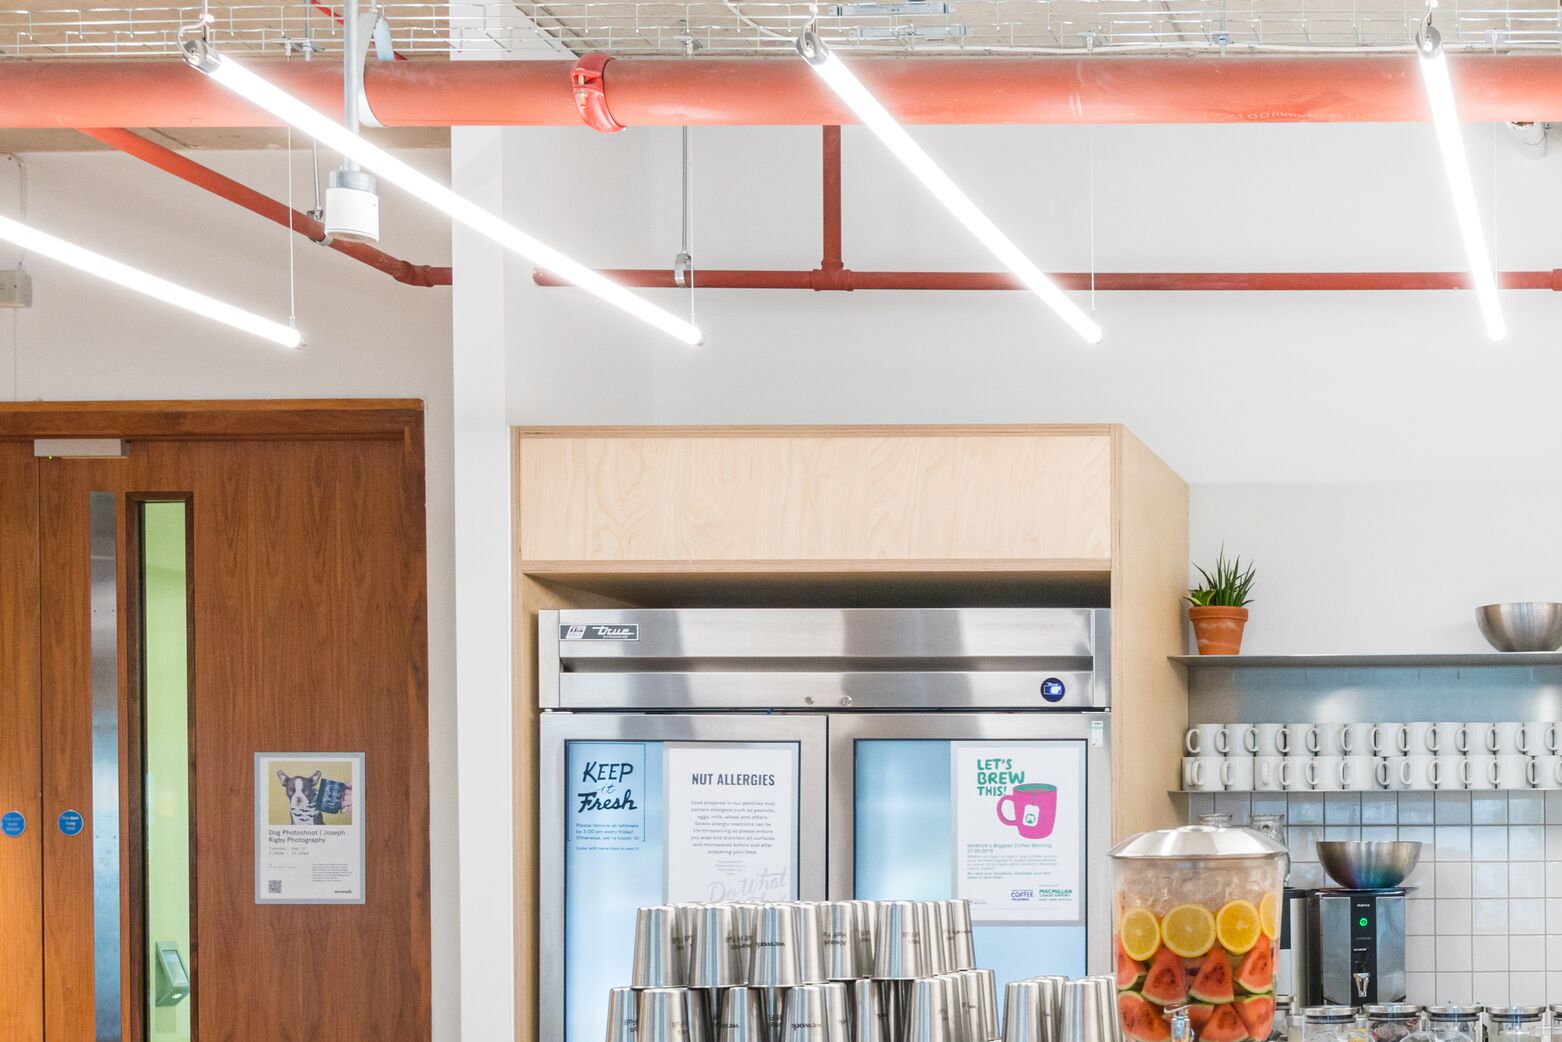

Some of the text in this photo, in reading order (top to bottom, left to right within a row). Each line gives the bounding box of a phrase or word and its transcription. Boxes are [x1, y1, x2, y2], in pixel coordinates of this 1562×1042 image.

[592, 626, 634, 636] true
[977, 758, 1013, 771] LET'S
[582, 761, 634, 783] KEEP
[977, 771, 1025, 785] BREW
[692, 773, 775, 786] NUT ALLERGIES
[977, 786, 1007, 797] THIS!
[578, 789, 637, 813] Fresh
